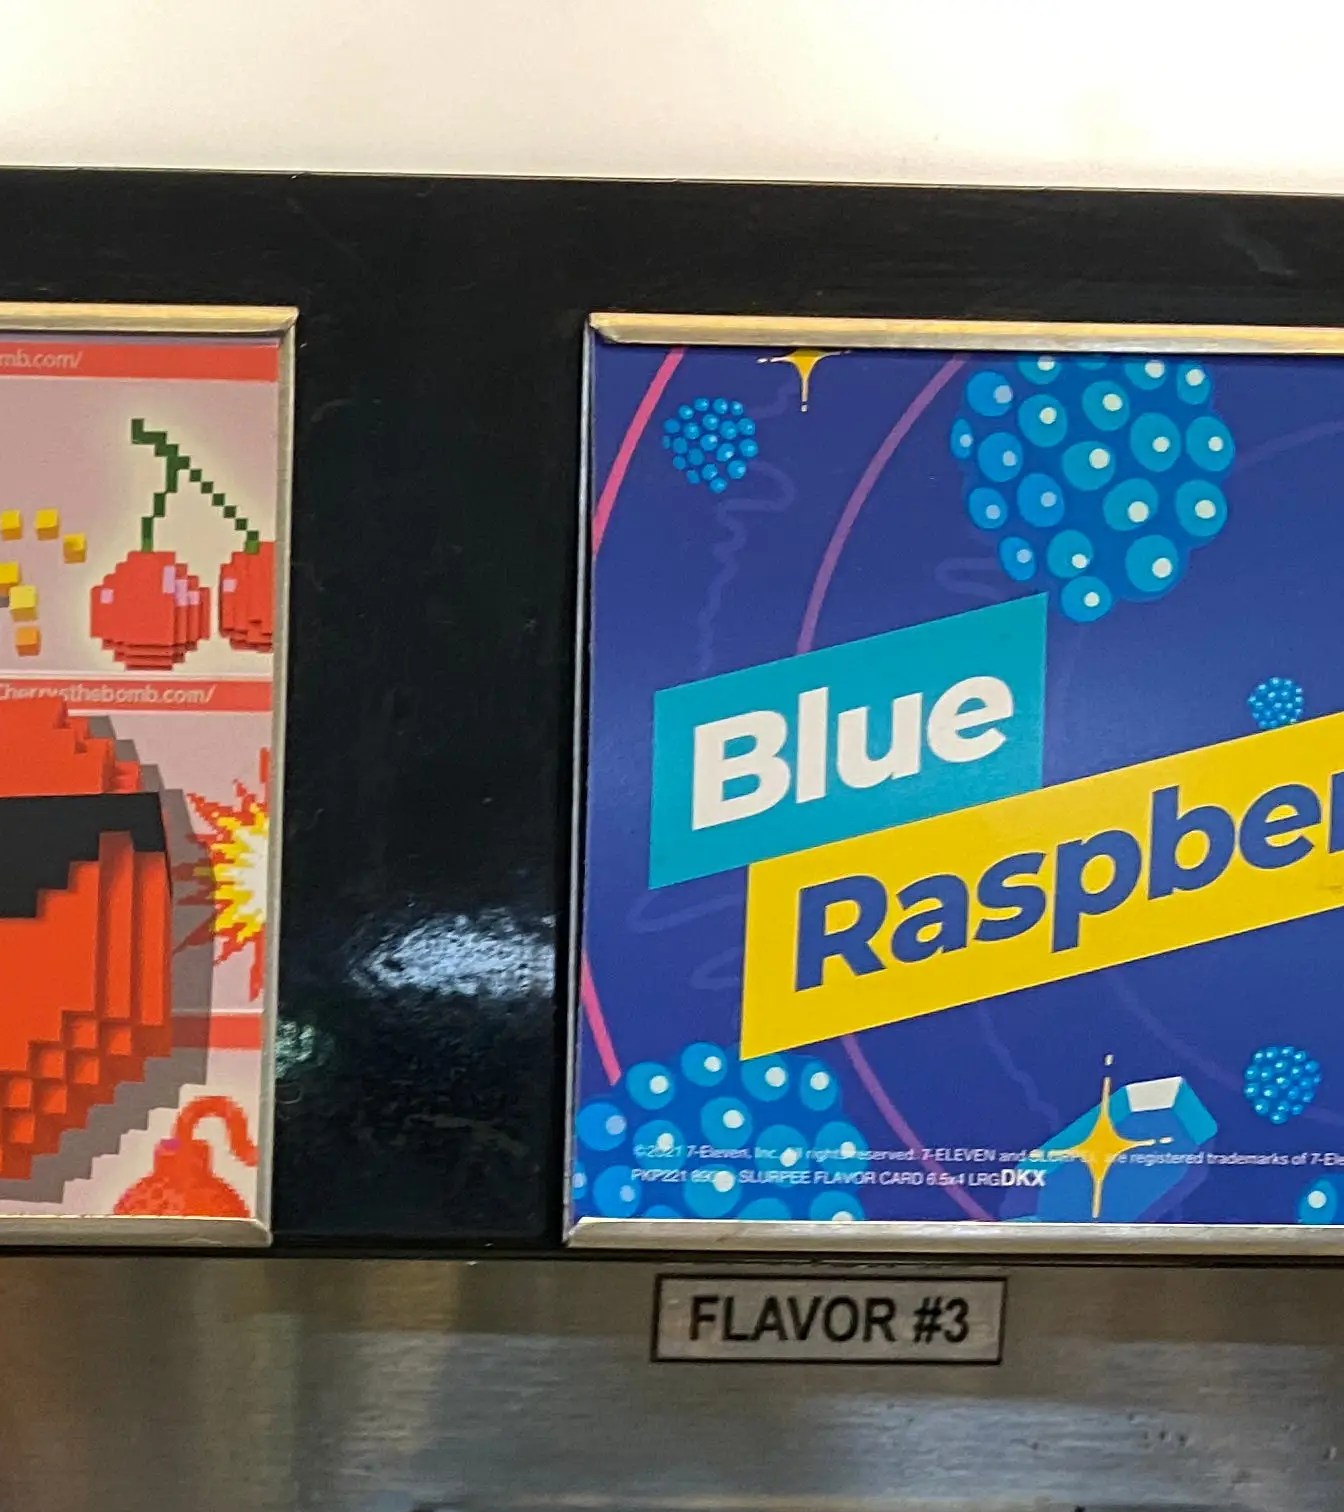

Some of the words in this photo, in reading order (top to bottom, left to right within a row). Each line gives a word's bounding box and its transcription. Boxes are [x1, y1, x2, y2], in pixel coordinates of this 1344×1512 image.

[691, 675, 1015, 832] Blue
[795, 772, 1344, 993] Raspbe
[738, 1169, 811, 1184] SLURPEE
[813, 1170, 876, 1185] FLAVOR
[879, 1171, 924, 1185] CARD
[920, 1148, 997, 1162] 7-ELEVEN
[688, 1294, 896, 1342] FLAVOR
[914, 1296, 969, 1343] #3
